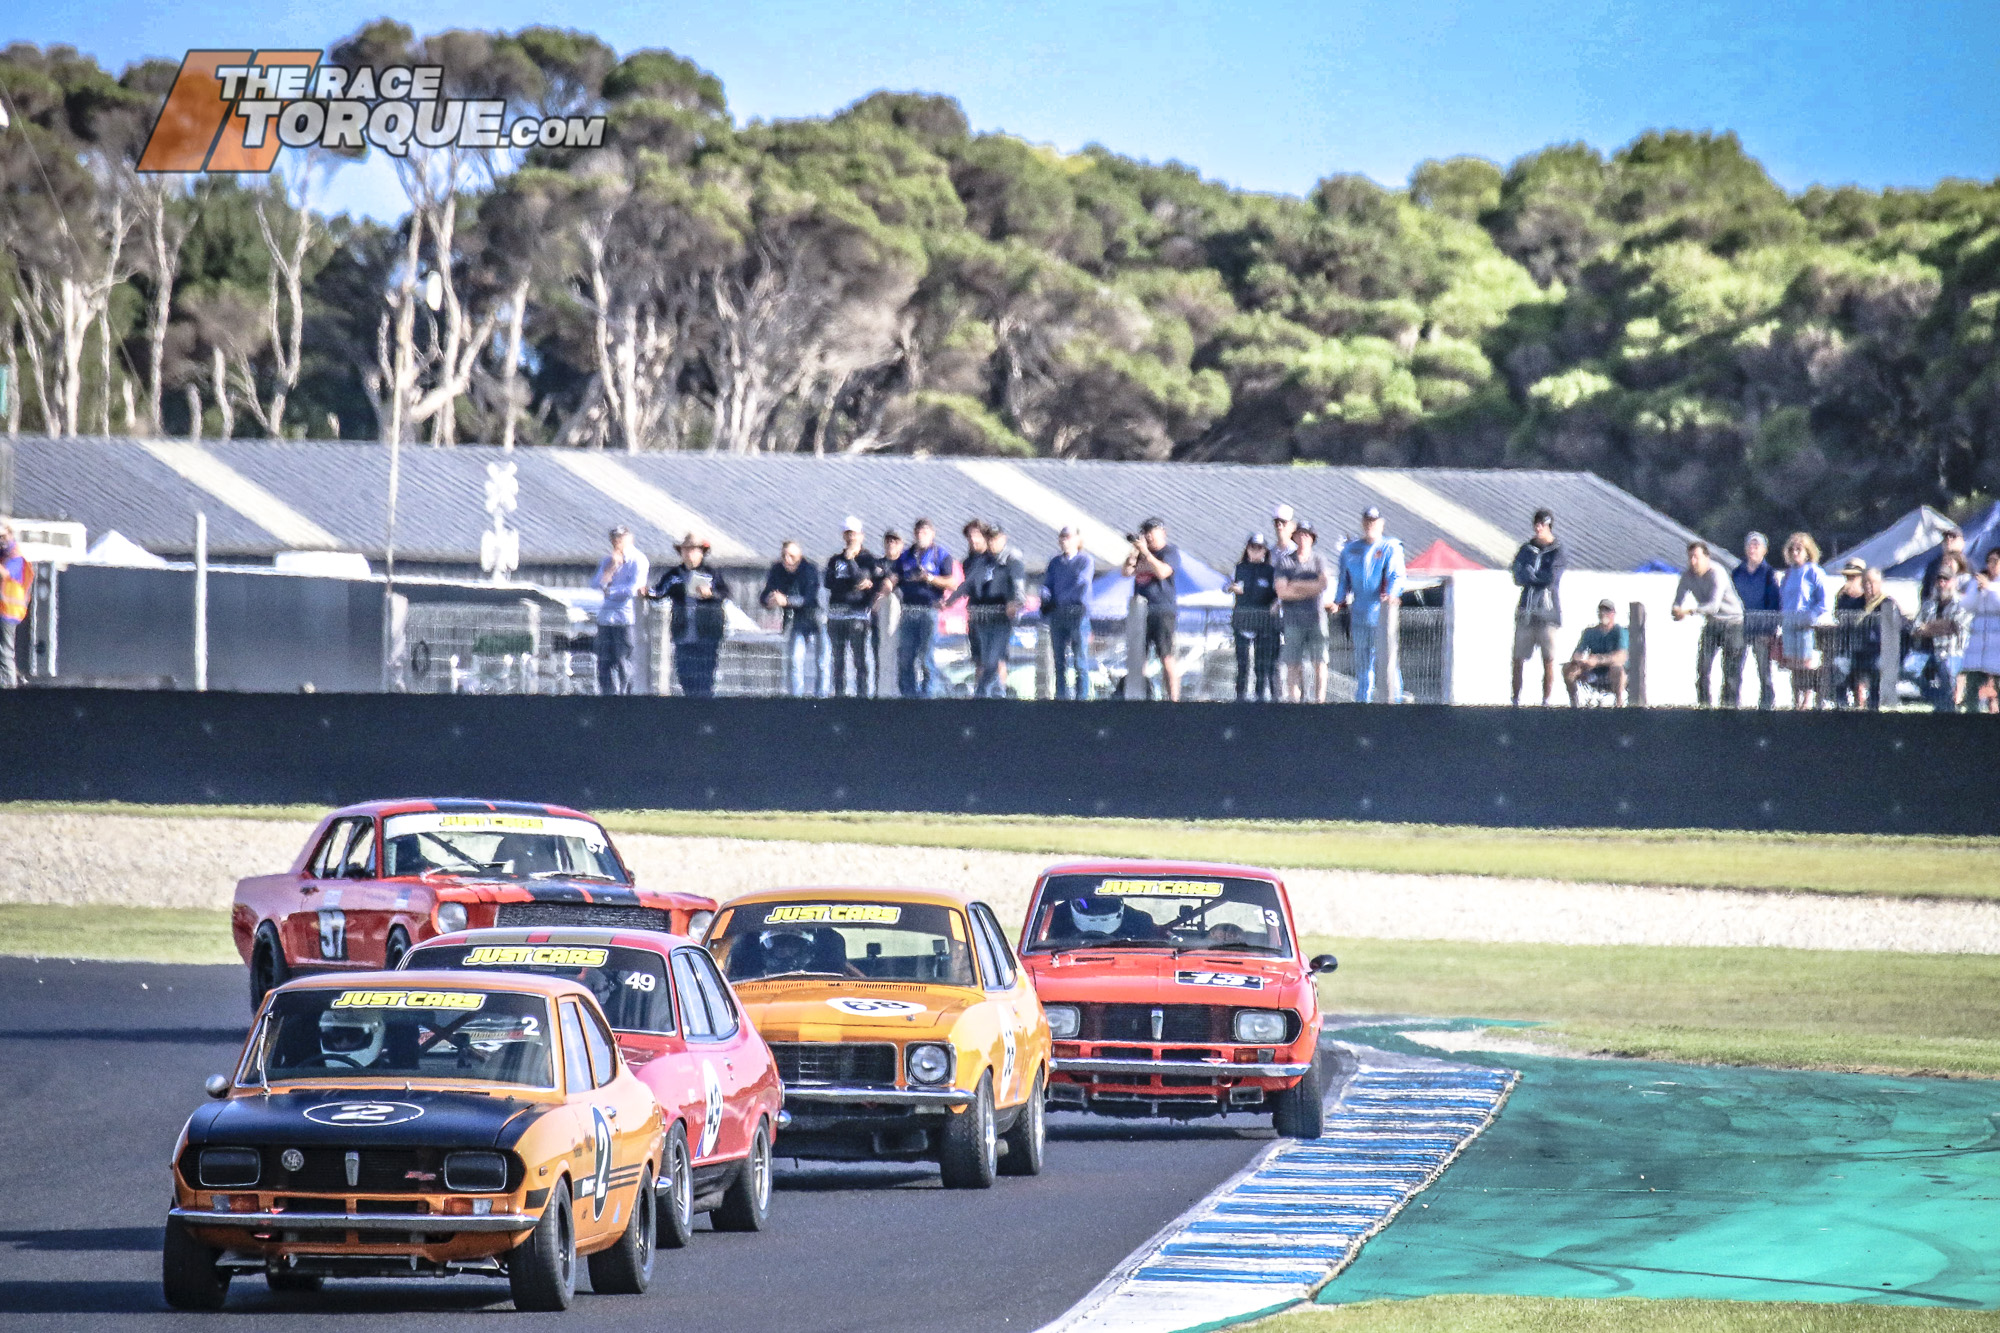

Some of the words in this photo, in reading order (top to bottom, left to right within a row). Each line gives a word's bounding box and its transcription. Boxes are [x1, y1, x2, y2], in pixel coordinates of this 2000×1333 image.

[439, 815, 486, 828] JUST
[1097, 880, 1159, 894] JUST
[1158, 882, 1222, 896] CARS
[767, 905, 832, 921] JUST
[830, 906, 900, 922] CARS
[1253, 908, 1280, 927] 13
[318, 910, 346, 958] 57
[465, 948, 534, 964] JUST
[532, 949, 607, 966] CARS
[624, 972, 656, 992] 49
[1190, 973, 1249, 986] 13
[334, 992, 407, 1007] JUST
[405, 993, 484, 1009] CARS
[521, 1016, 541, 1036] 2
[330, 1104, 395, 1121] 2
[707, 1083, 722, 1135] 49
[596, 1121, 608, 1200] 2
